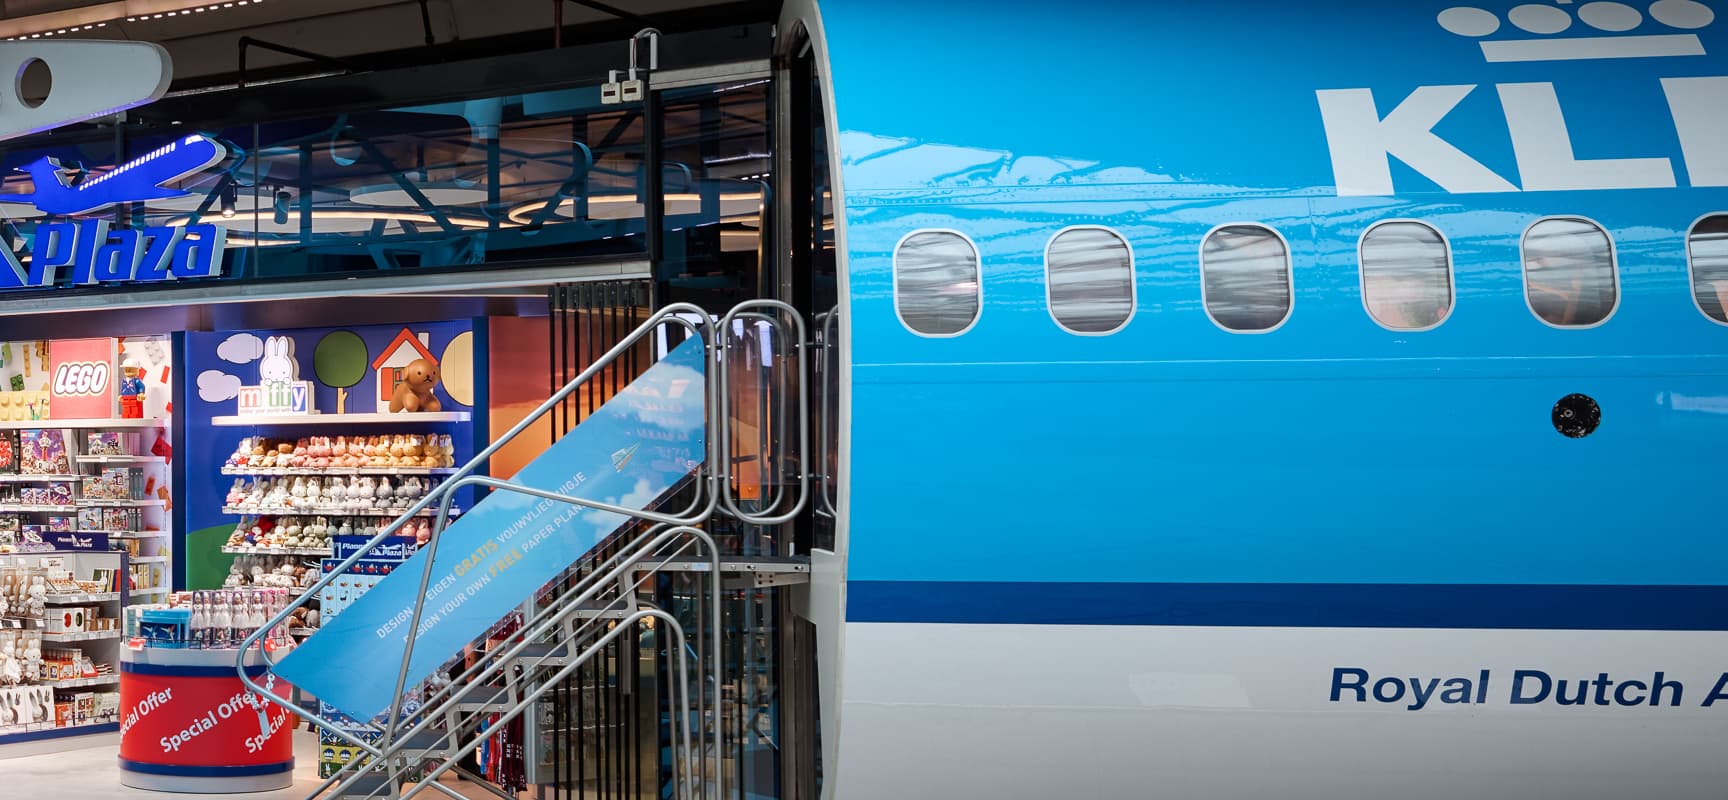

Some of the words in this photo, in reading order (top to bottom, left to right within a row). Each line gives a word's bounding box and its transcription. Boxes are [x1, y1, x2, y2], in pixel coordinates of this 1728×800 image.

[28, 218, 219, 286] Plaza
[55, 362, 108, 394] LEGO
[240, 382, 307, 412] mffy
[439, 592, 468, 617] YOUR
[466, 573, 491, 596] OWN
[489, 549, 523, 577] FREE
[521, 524, 555, 553] PAPER
[553, 505, 588, 528] PLAN
[376, 606, 414, 639] DESIGN
[425, 573, 456, 601] EIGEN
[454, 541, 499, 577] GRATIS
[138, 687, 173, 716] Offer
[1329, 667, 1490, 711] Royal
[1509, 670, 1684, 706] Dutch
[160, 711, 218, 753] Special
[217, 692, 258, 720] Offe
